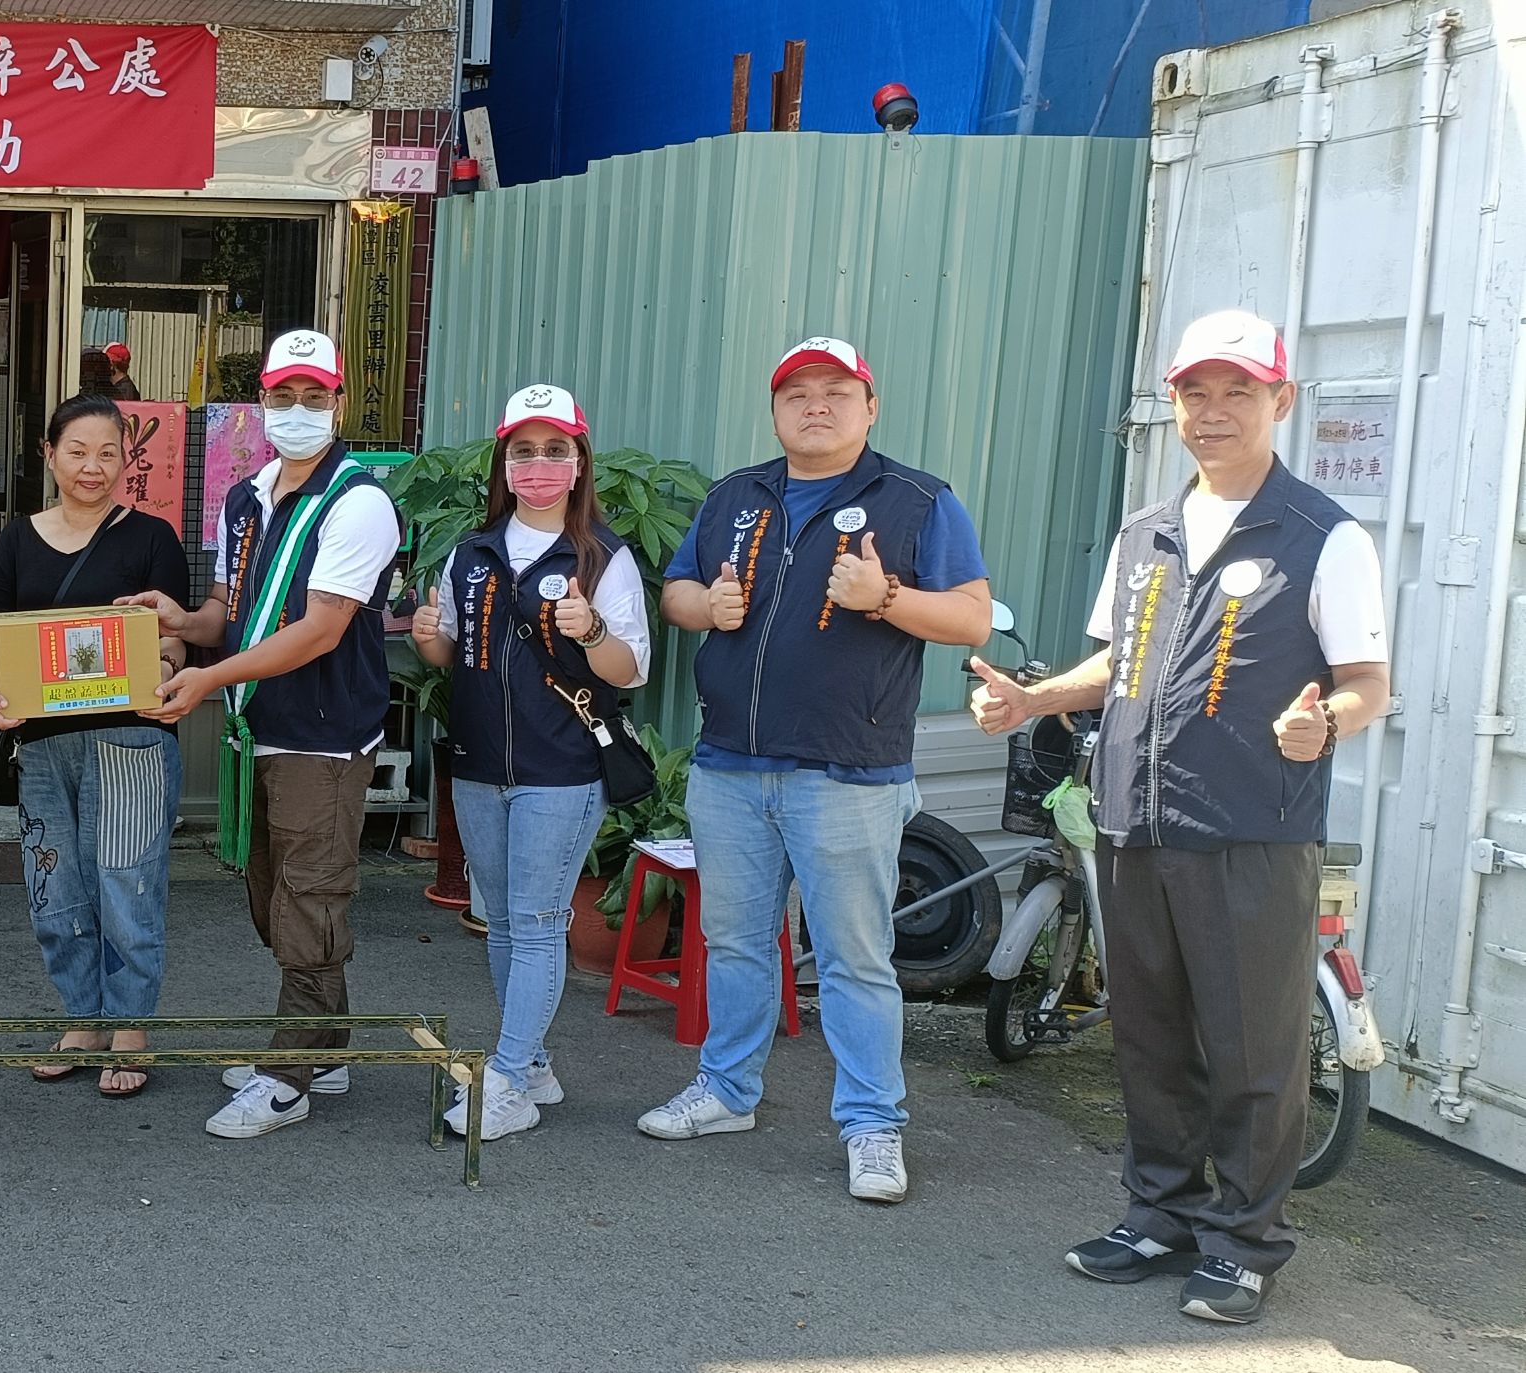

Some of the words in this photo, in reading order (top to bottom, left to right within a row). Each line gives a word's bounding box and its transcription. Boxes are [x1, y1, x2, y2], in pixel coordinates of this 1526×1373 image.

[391, 166, 424, 189] 42
[360, 272, 391, 434] 凌雲里辦公處
[1314, 455, 1383, 482] 請勿停車
[1204, 598, 1243, 719] 隆祥經濟發展基金會
